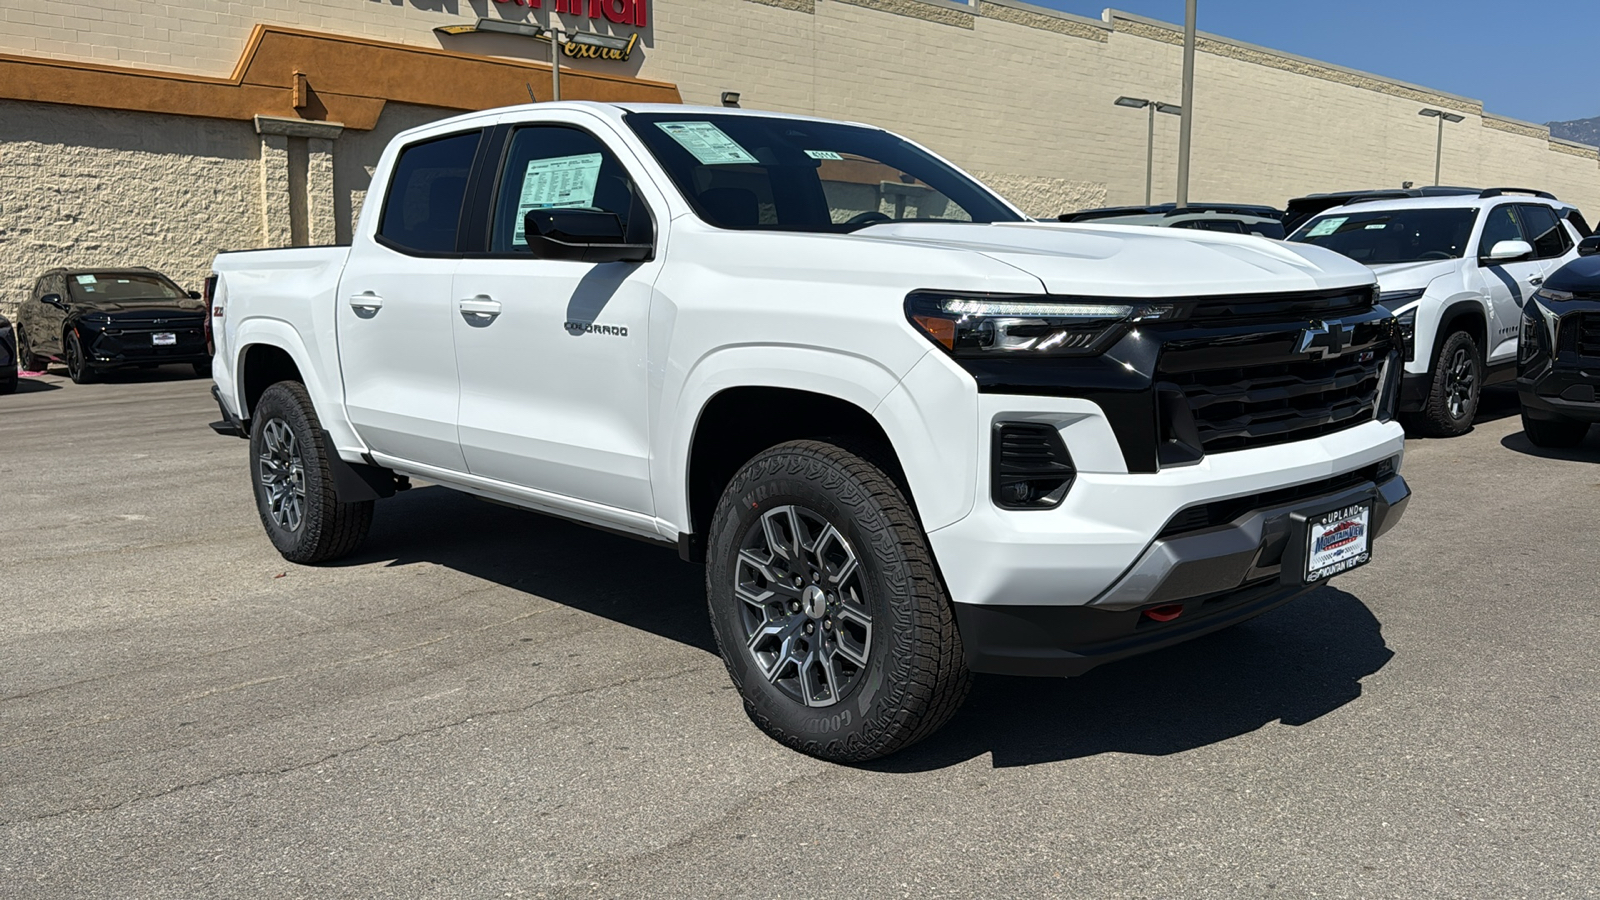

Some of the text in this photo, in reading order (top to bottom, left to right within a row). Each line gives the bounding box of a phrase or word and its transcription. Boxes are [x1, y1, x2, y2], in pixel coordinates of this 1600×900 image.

[563, 321, 628, 337] COLORADO
[1328, 505, 1358, 523] UPLAND
[1322, 558, 1357, 577] MOUNTAIN VIEW
